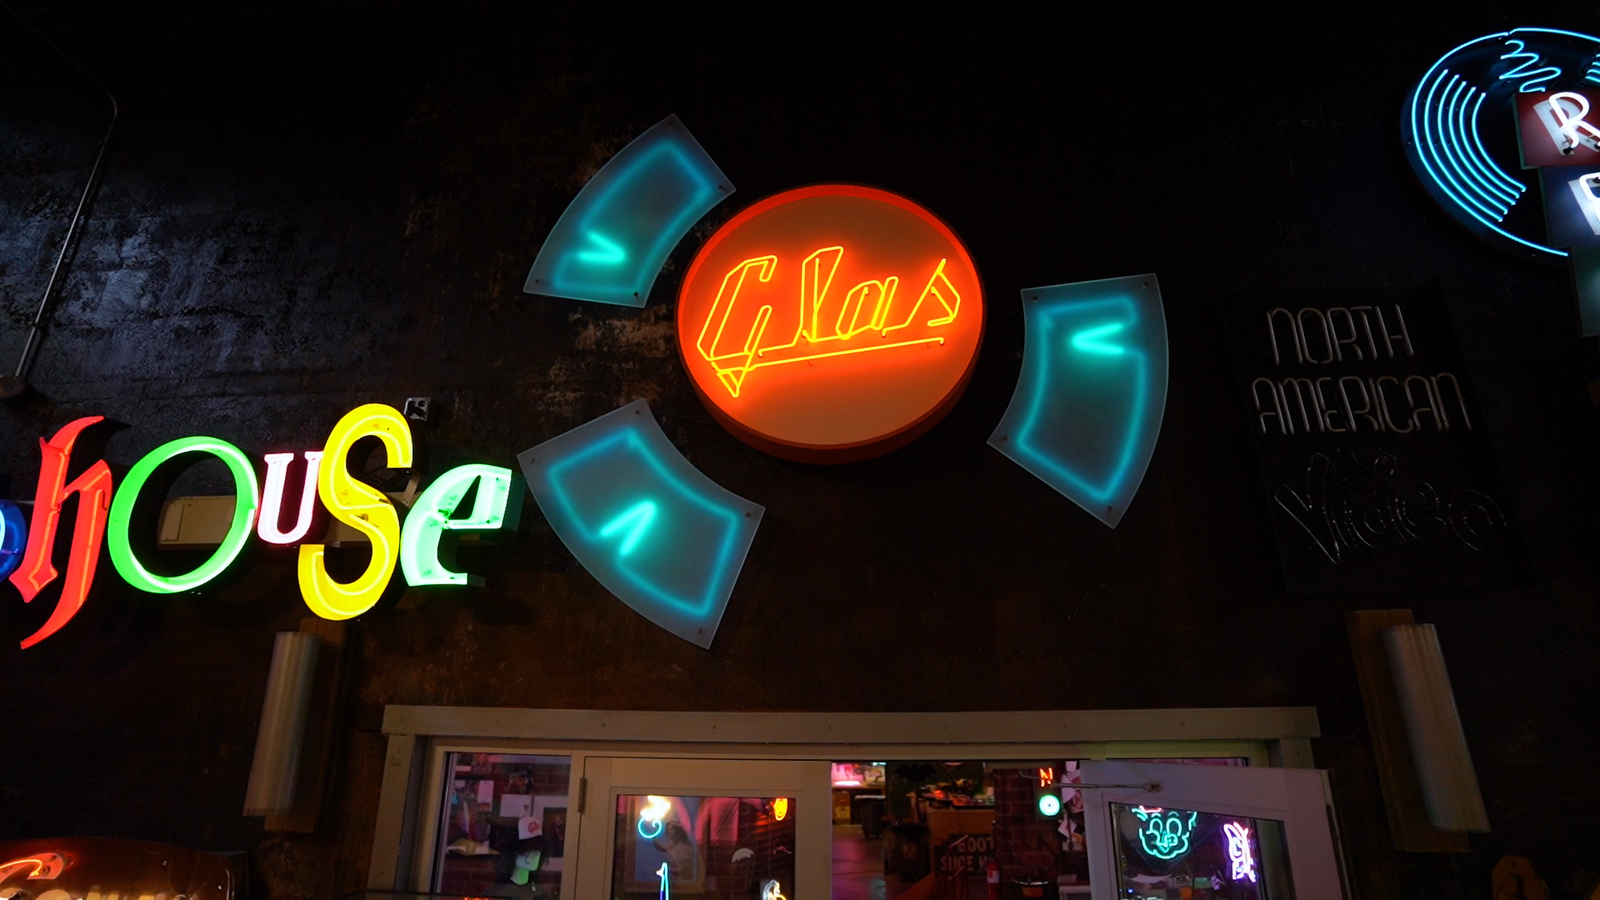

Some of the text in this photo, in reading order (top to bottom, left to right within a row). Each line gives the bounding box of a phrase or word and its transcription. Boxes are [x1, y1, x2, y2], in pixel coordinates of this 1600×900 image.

[697, 245, 961, 397] Glas
[1266, 303, 1414, 366] NORTH
[1251, 372, 1472, 435] AMERICAN
